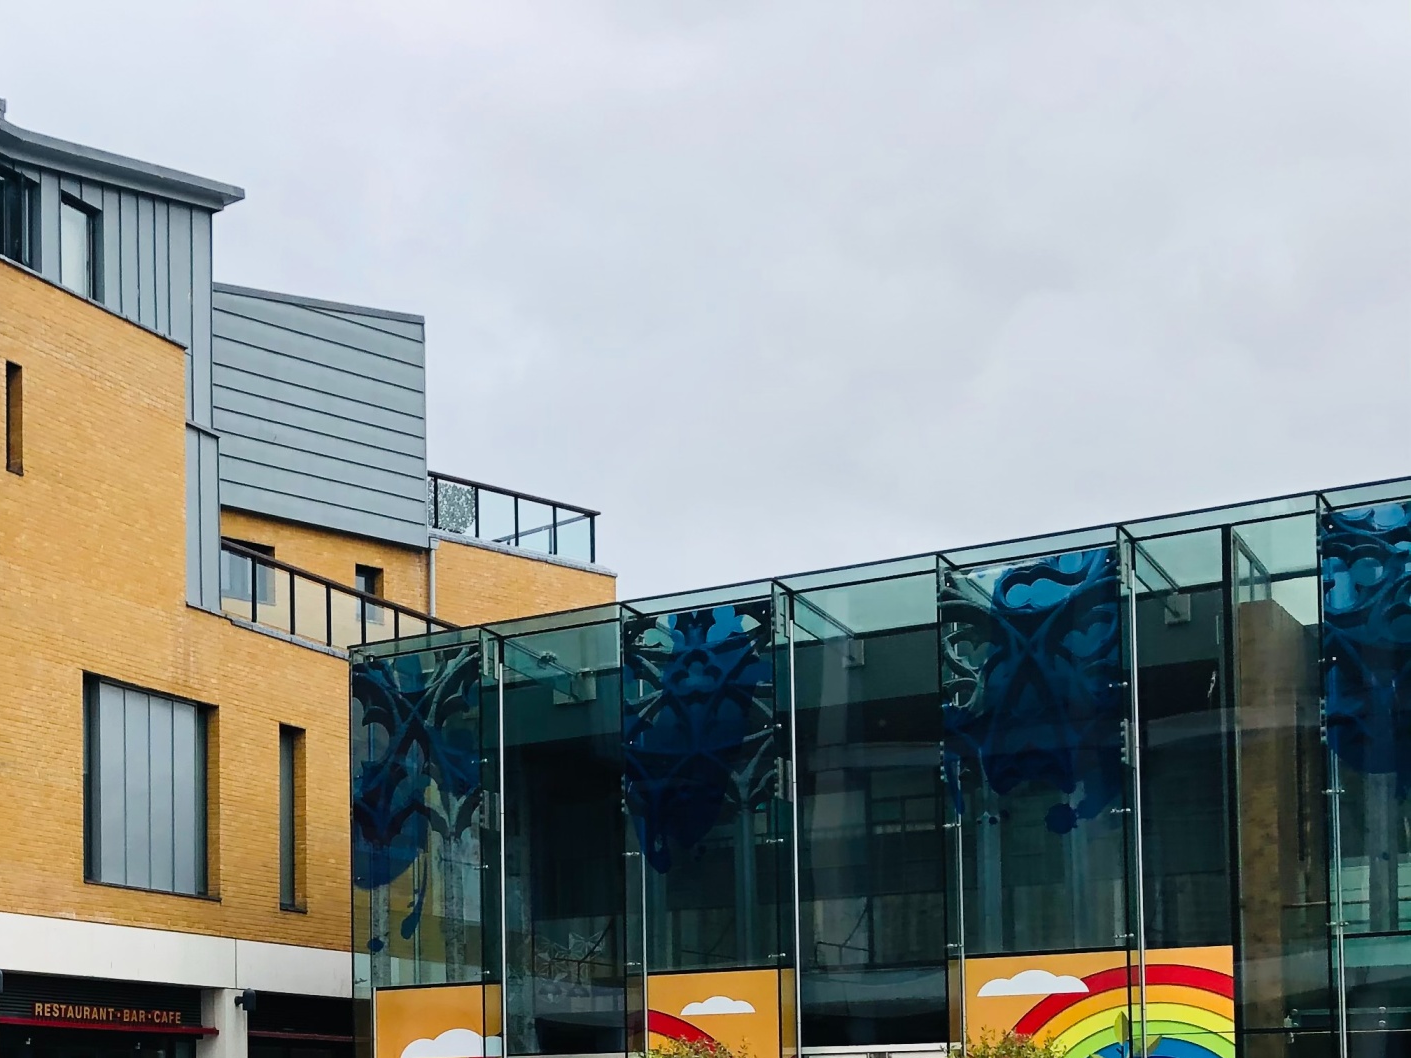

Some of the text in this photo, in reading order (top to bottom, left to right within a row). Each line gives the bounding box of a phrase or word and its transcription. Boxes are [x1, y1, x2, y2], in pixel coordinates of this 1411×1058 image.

[35, 1002, 182, 1024] RESTAURANT BAR CAFE
